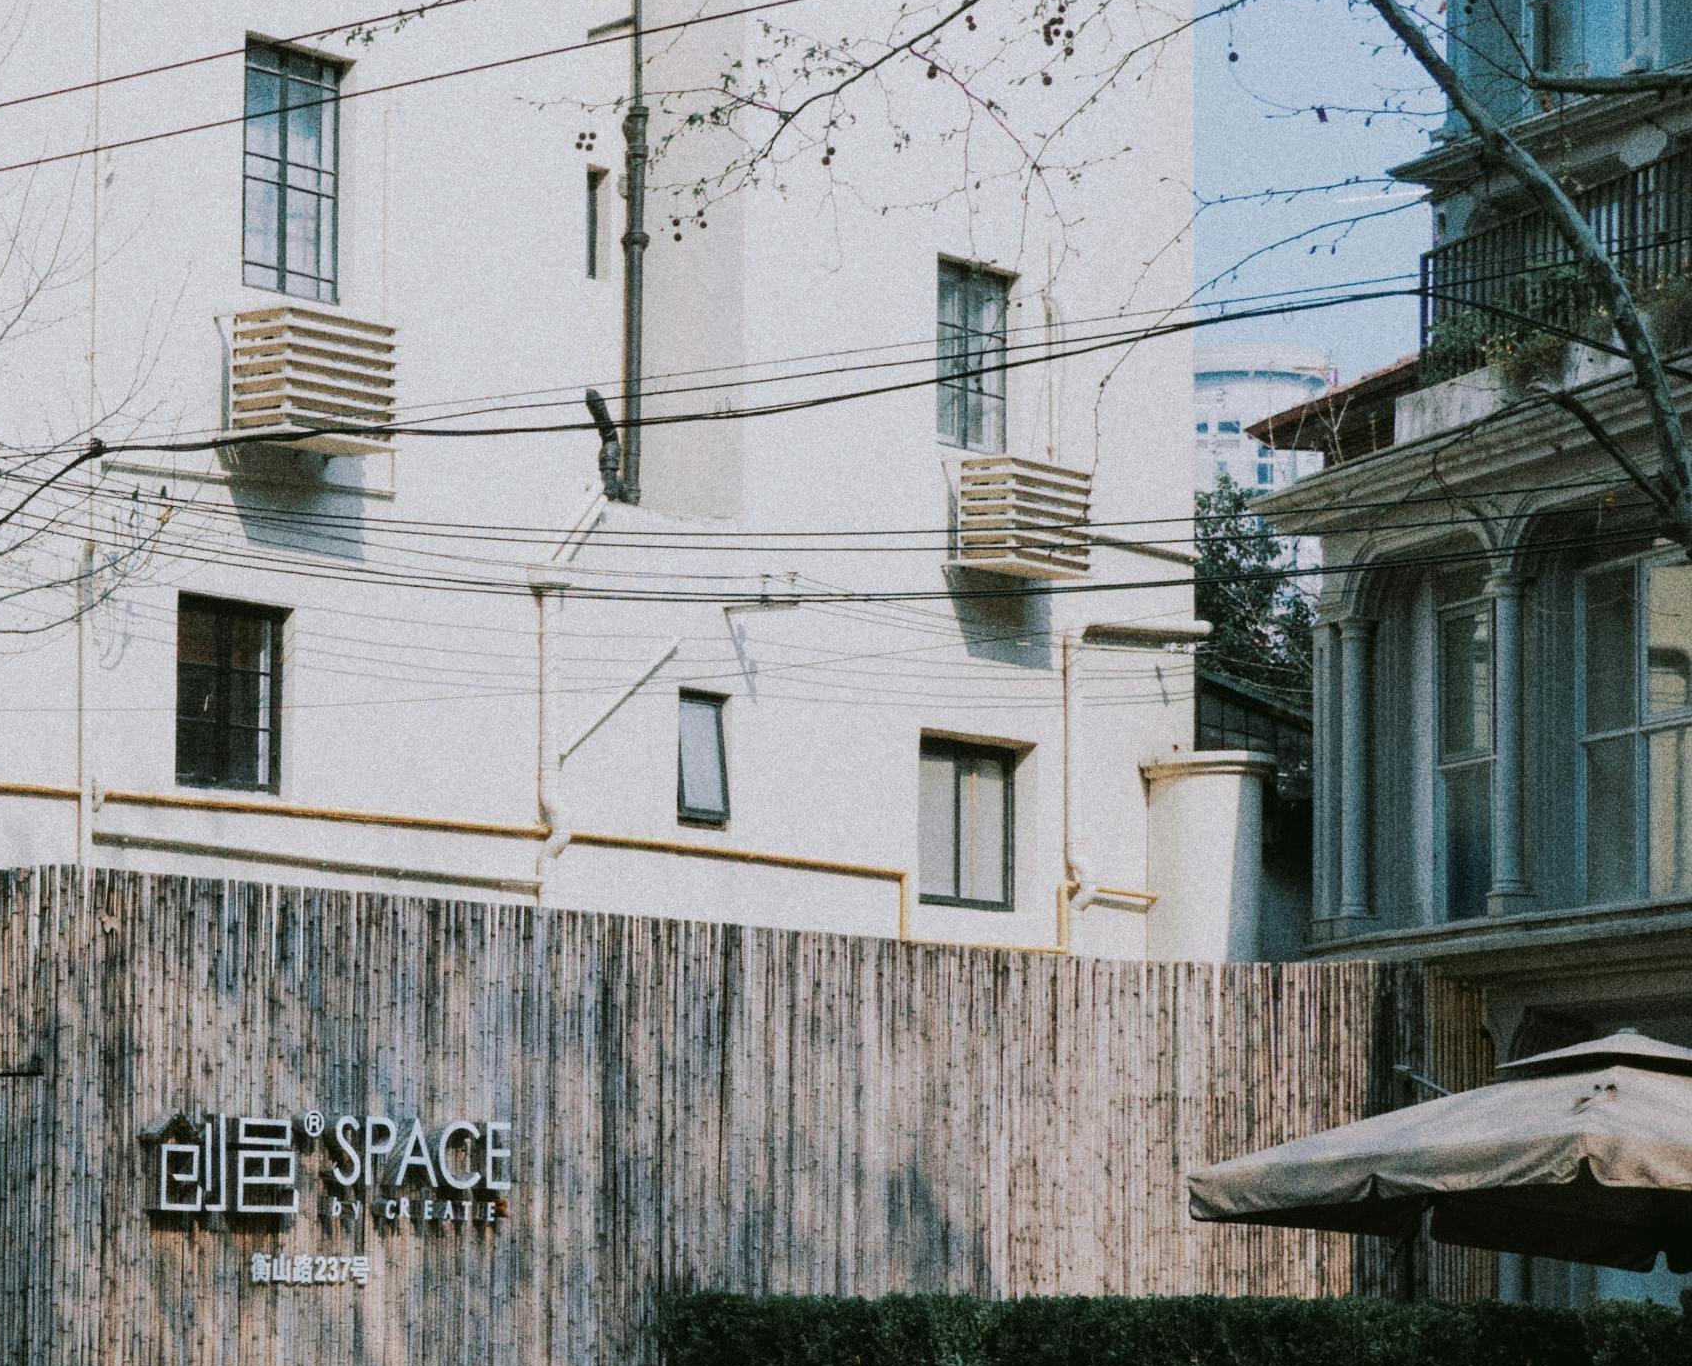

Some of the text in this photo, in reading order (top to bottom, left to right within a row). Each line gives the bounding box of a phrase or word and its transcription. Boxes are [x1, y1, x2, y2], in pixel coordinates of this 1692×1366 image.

[331, 1114, 511, 1190] SPACE
[332, 1196, 497, 1222] by CREATE
[251, 1252, 370, 1284] 衡山路237号
